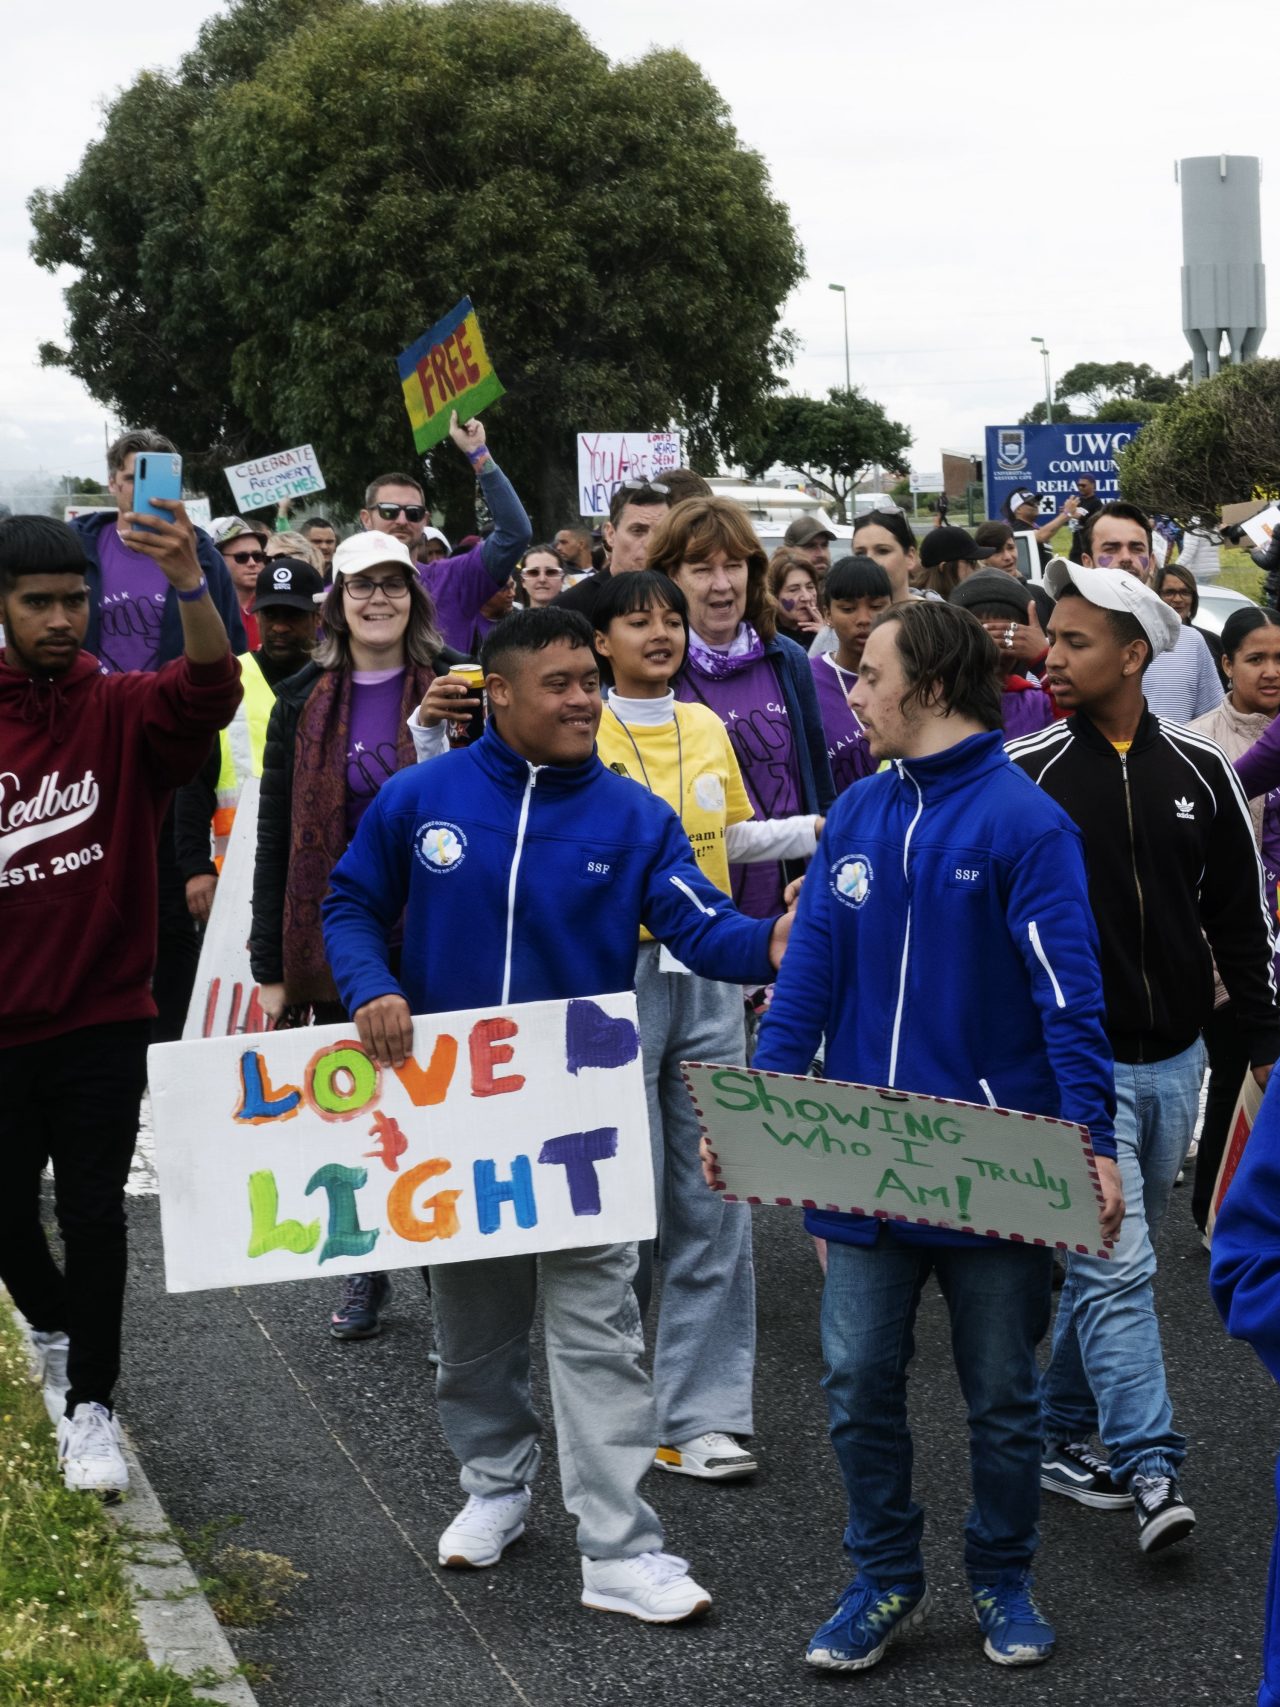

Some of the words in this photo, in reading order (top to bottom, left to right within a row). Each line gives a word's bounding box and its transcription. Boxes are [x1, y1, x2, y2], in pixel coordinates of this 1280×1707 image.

[416, 323, 480, 417] FREE
[652, 454, 674, 465] SEEN
[1064, 432, 1131, 455] UWC
[235, 446, 313, 478] CELEBRATE
[249, 464, 313, 490] RECOVERY
[241, 475, 321, 507] TOGETHER
[98, 591, 130, 607] ALK
[827, 727, 863, 759] WALK
[50, 843, 104, 876] 2003
[587, 861, 611, 875] SSF
[955, 868, 980, 881] SSF
[892, 1136, 934, 1168] I
[246, 1126, 618, 1266] LIGHT
